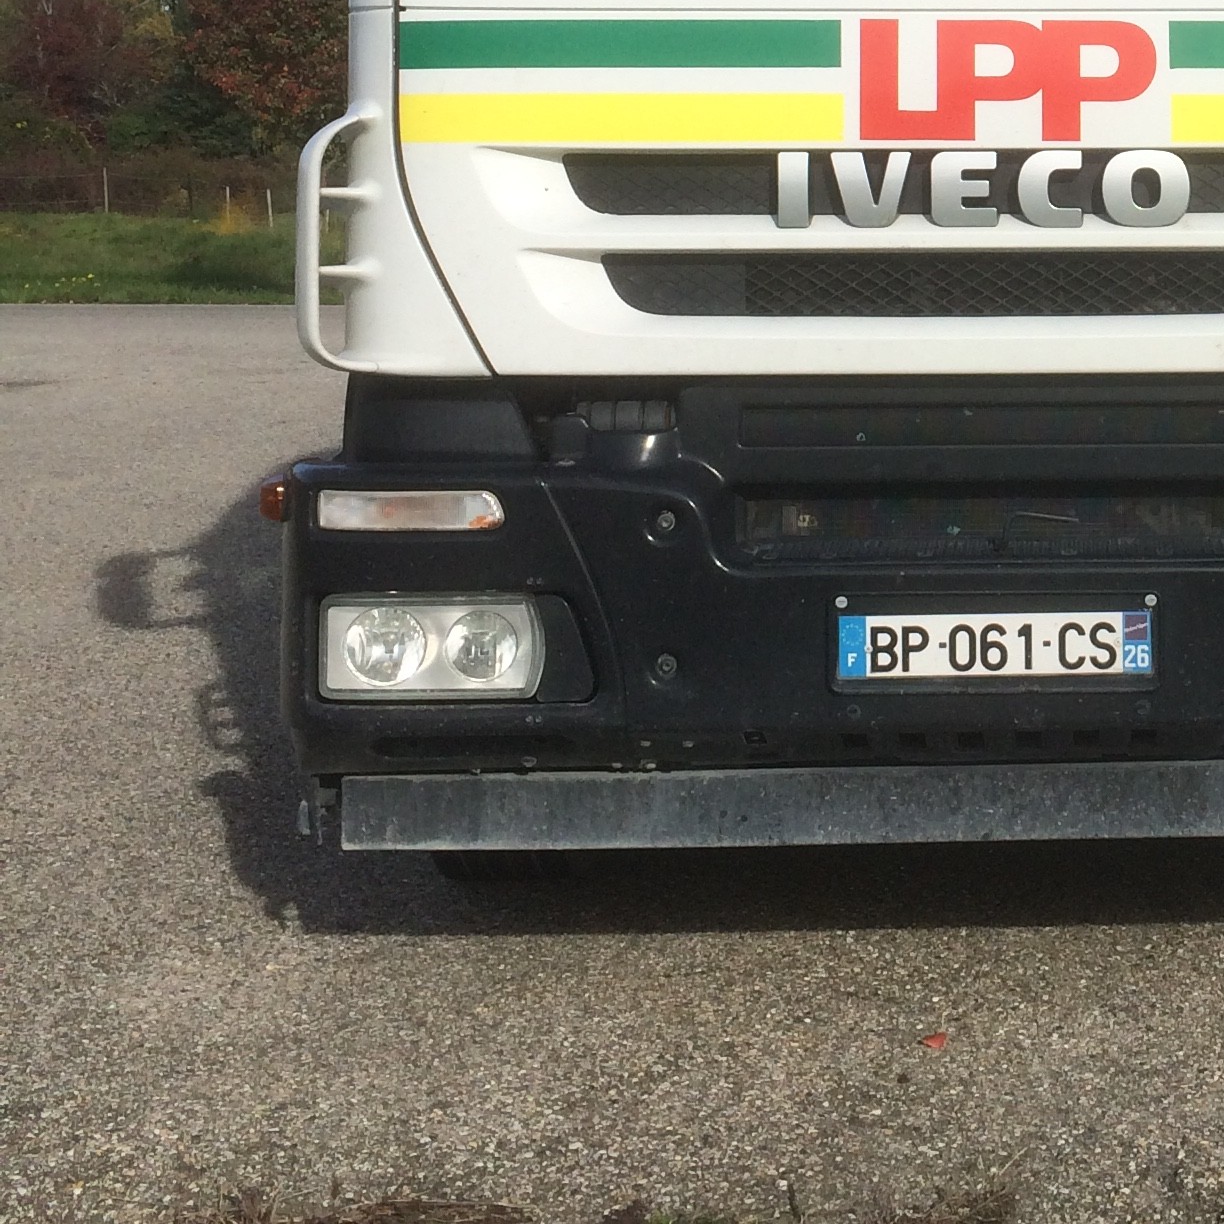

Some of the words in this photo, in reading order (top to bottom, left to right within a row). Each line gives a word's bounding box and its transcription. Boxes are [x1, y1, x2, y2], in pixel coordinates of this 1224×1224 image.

[859, 18, 1158, 142] LPP
[776, 149, 1191, 229] IVECO
[847, 653, 857, 668] F
[869, 621, 1118, 673] BP-061-CS
[1124, 644, 1150, 669] 26
